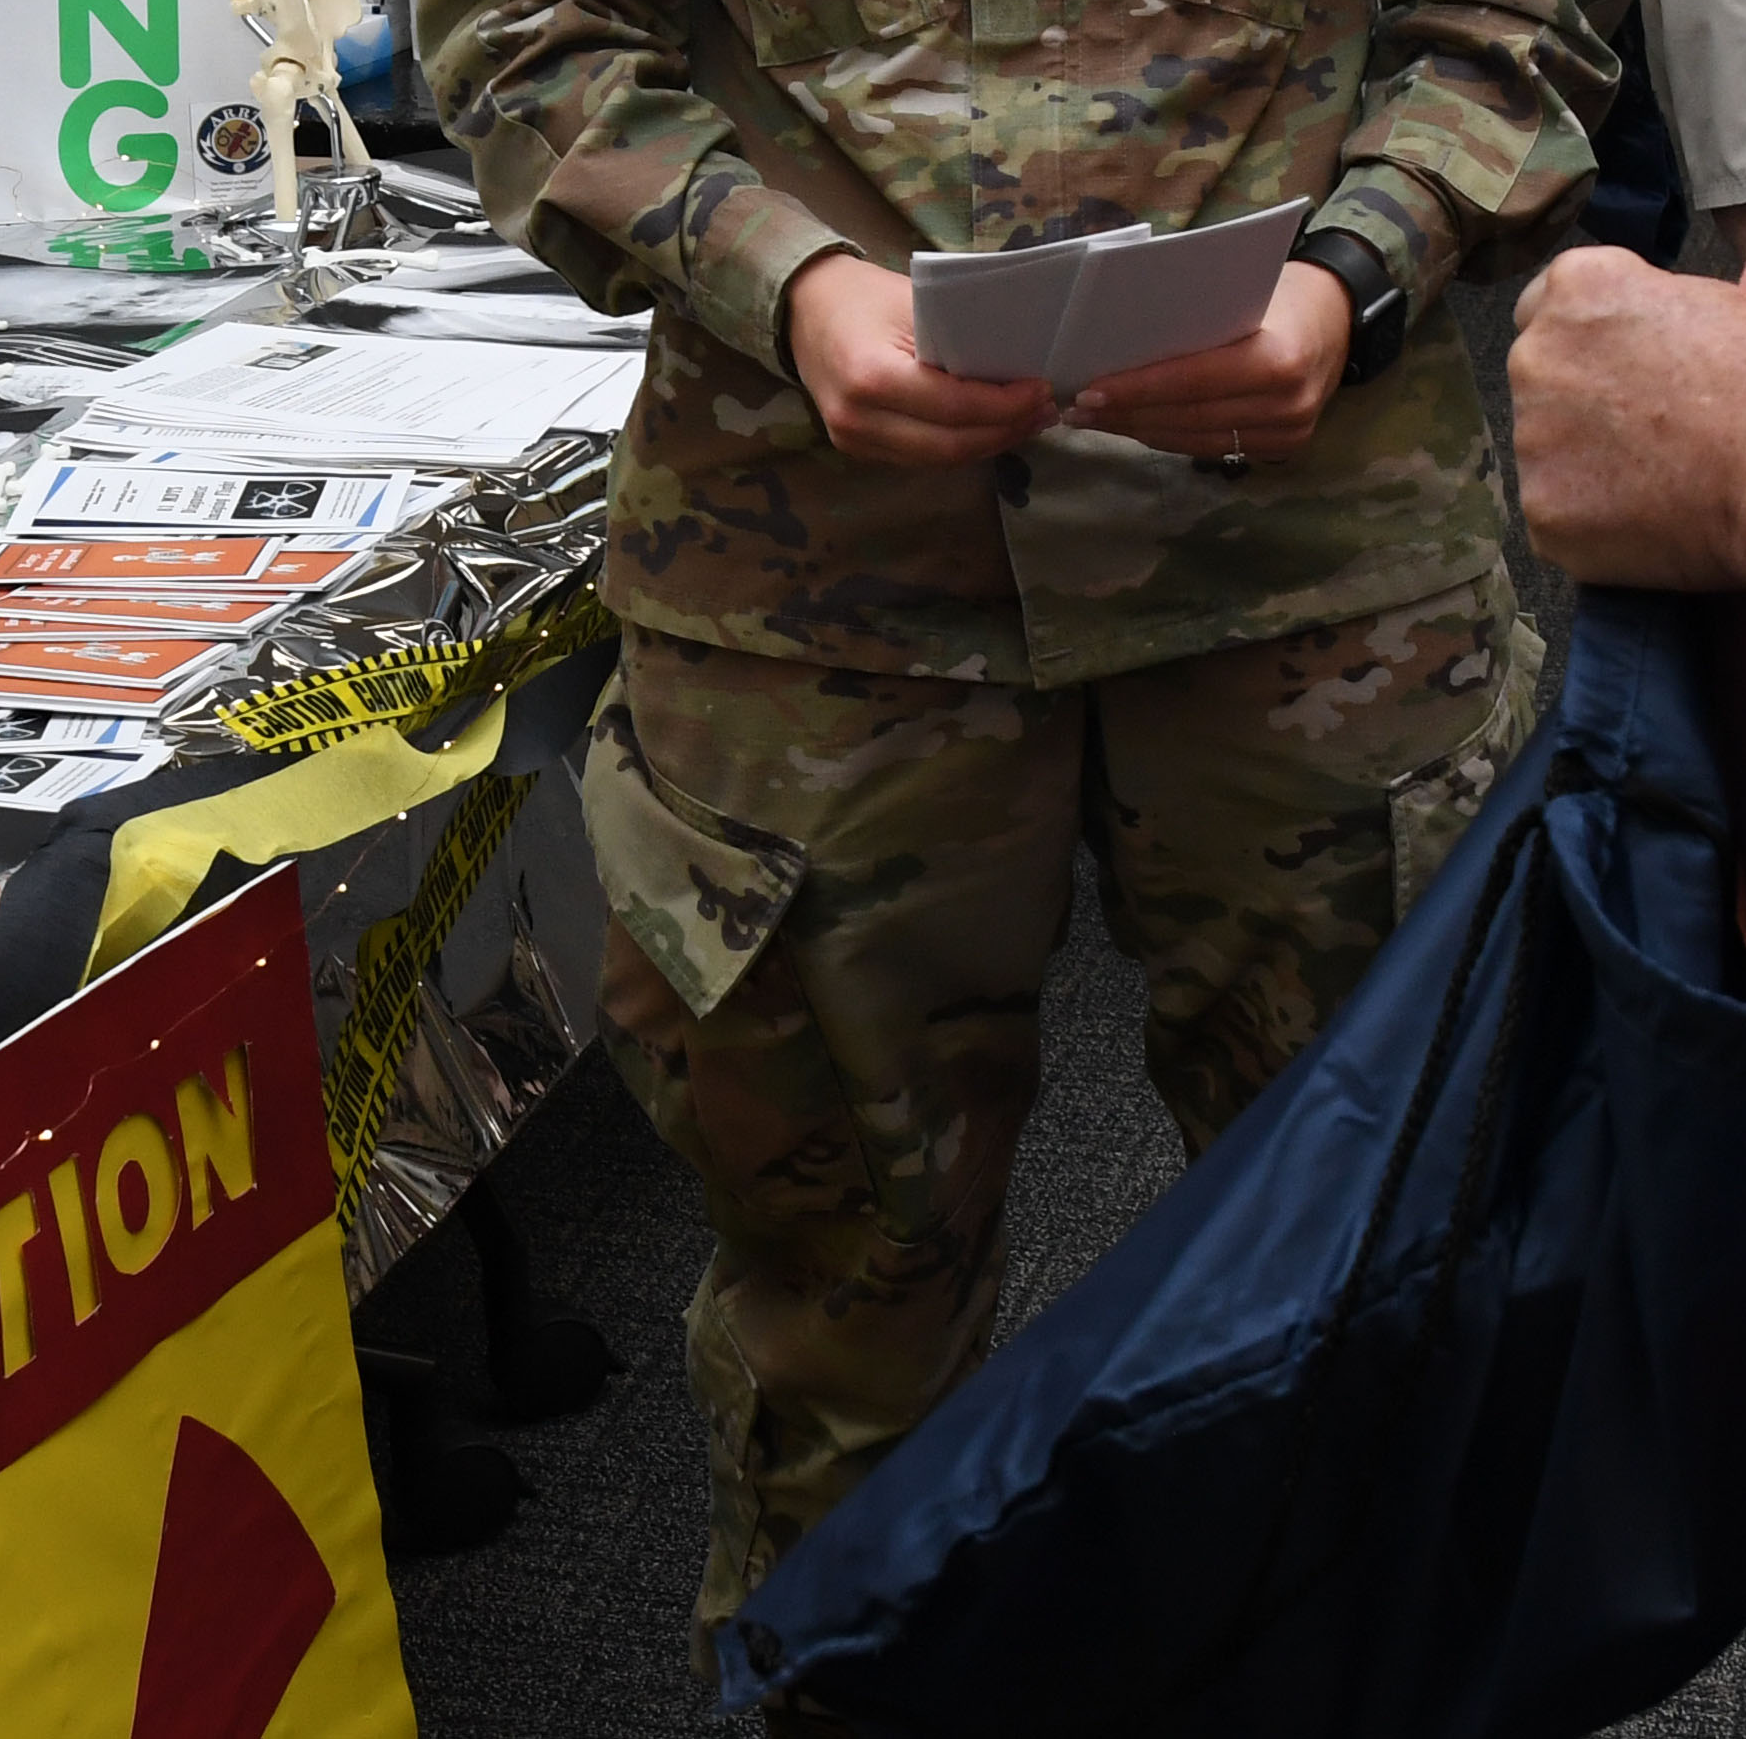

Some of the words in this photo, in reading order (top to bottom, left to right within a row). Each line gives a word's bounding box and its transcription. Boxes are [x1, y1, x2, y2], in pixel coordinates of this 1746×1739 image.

[239, 687, 353, 740] CAUTION
[348, 665, 433, 715] CAUTION
[459, 774, 515, 862] CAUTION
[361, 948, 419, 1054] CAUTION
[330, 1054, 376, 1158] CAUTION
